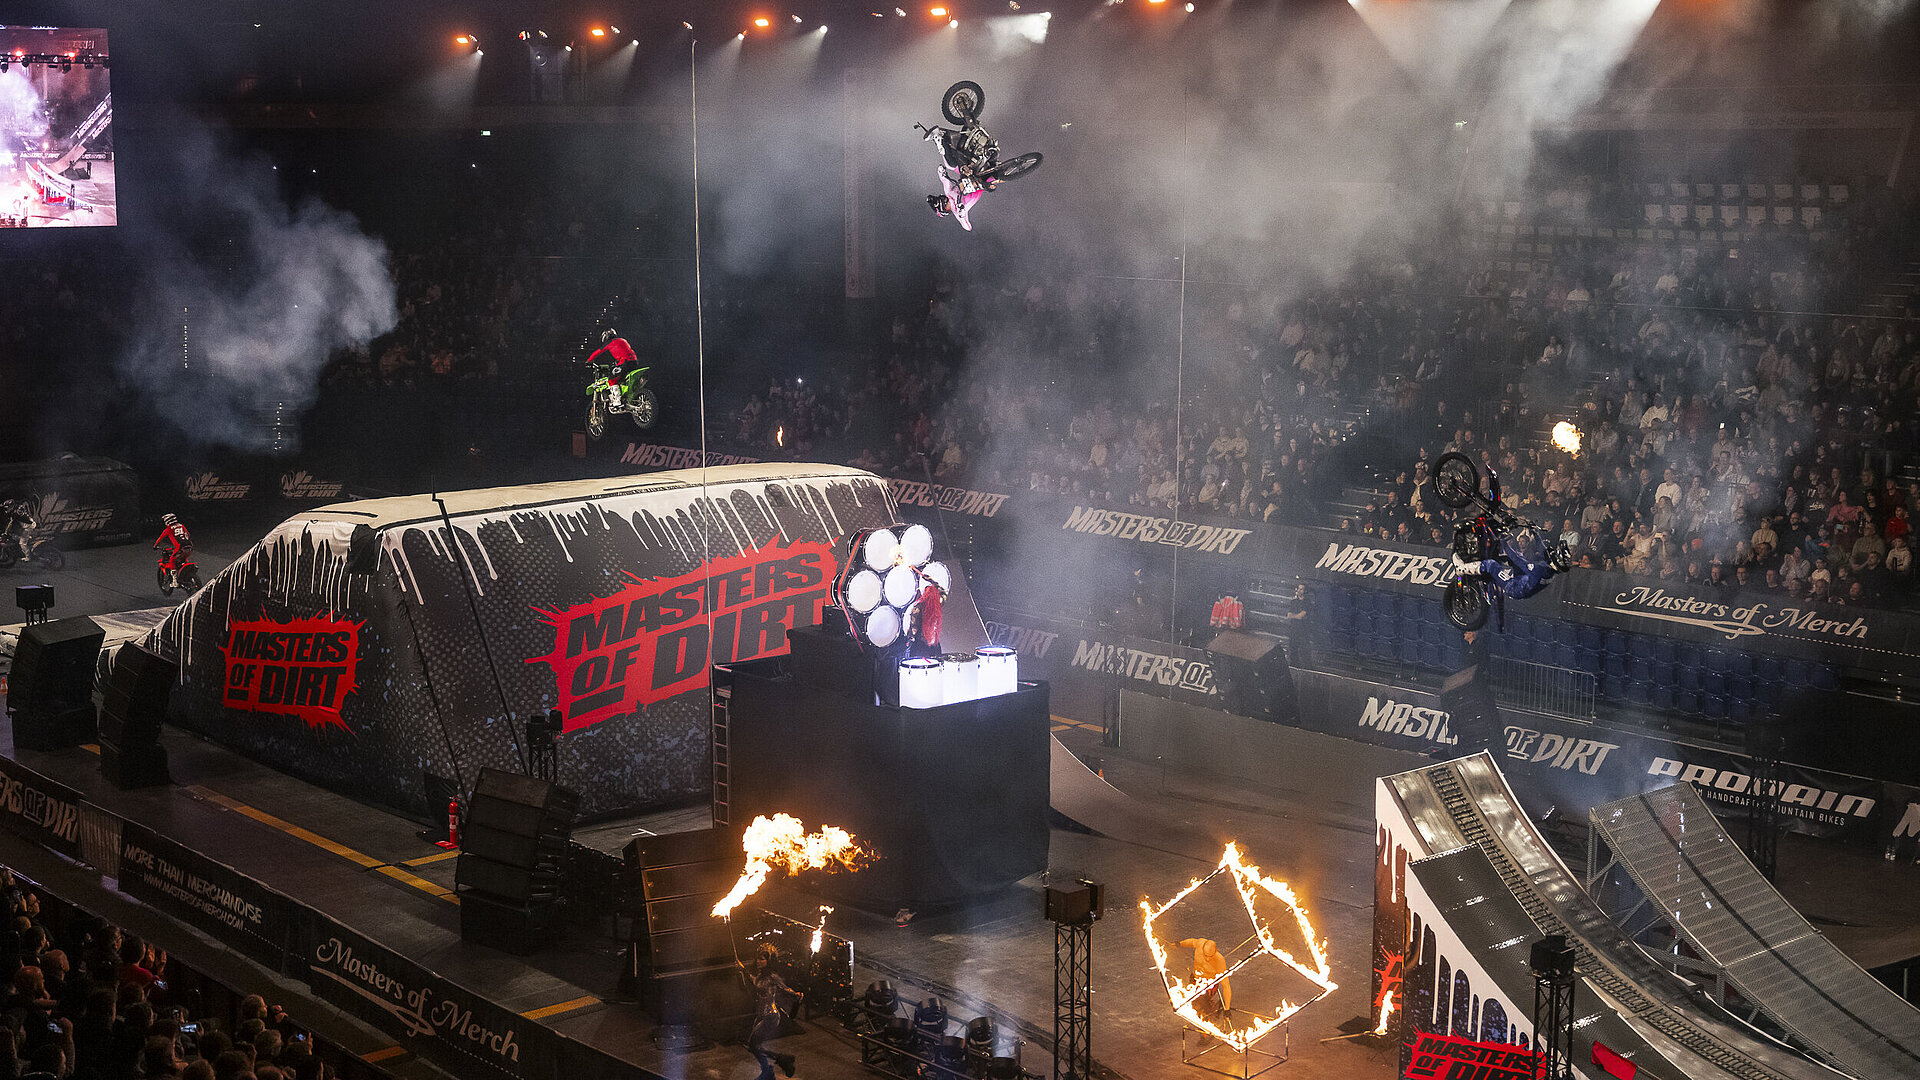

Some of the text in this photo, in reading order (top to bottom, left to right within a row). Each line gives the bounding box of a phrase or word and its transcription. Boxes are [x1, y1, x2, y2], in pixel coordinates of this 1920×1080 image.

[886, 477, 1010, 518] STERS OF DIRT
[1063, 505, 1253, 555] MASTERS OF DIRT
[1315, 542, 1447, 585] MASTERS
[565, 553, 823, 659] MASTERS
[1615, 586, 1869, 639] Masters of Merch
[230, 629, 351, 663] MASTERS
[570, 588, 827, 696] OF DIRT
[229, 662, 347, 708] OF DIRT
[1503, 725, 1540, 760] OF
[1530, 733, 1621, 776] DIRT
[1819, 812, 1845, 827] BIKES
[124, 844, 262, 924] MORE THAN MERCHANDISE
[316, 937, 519, 1063] Masters of Merch
[1415, 1055, 1446, 1071] OF
